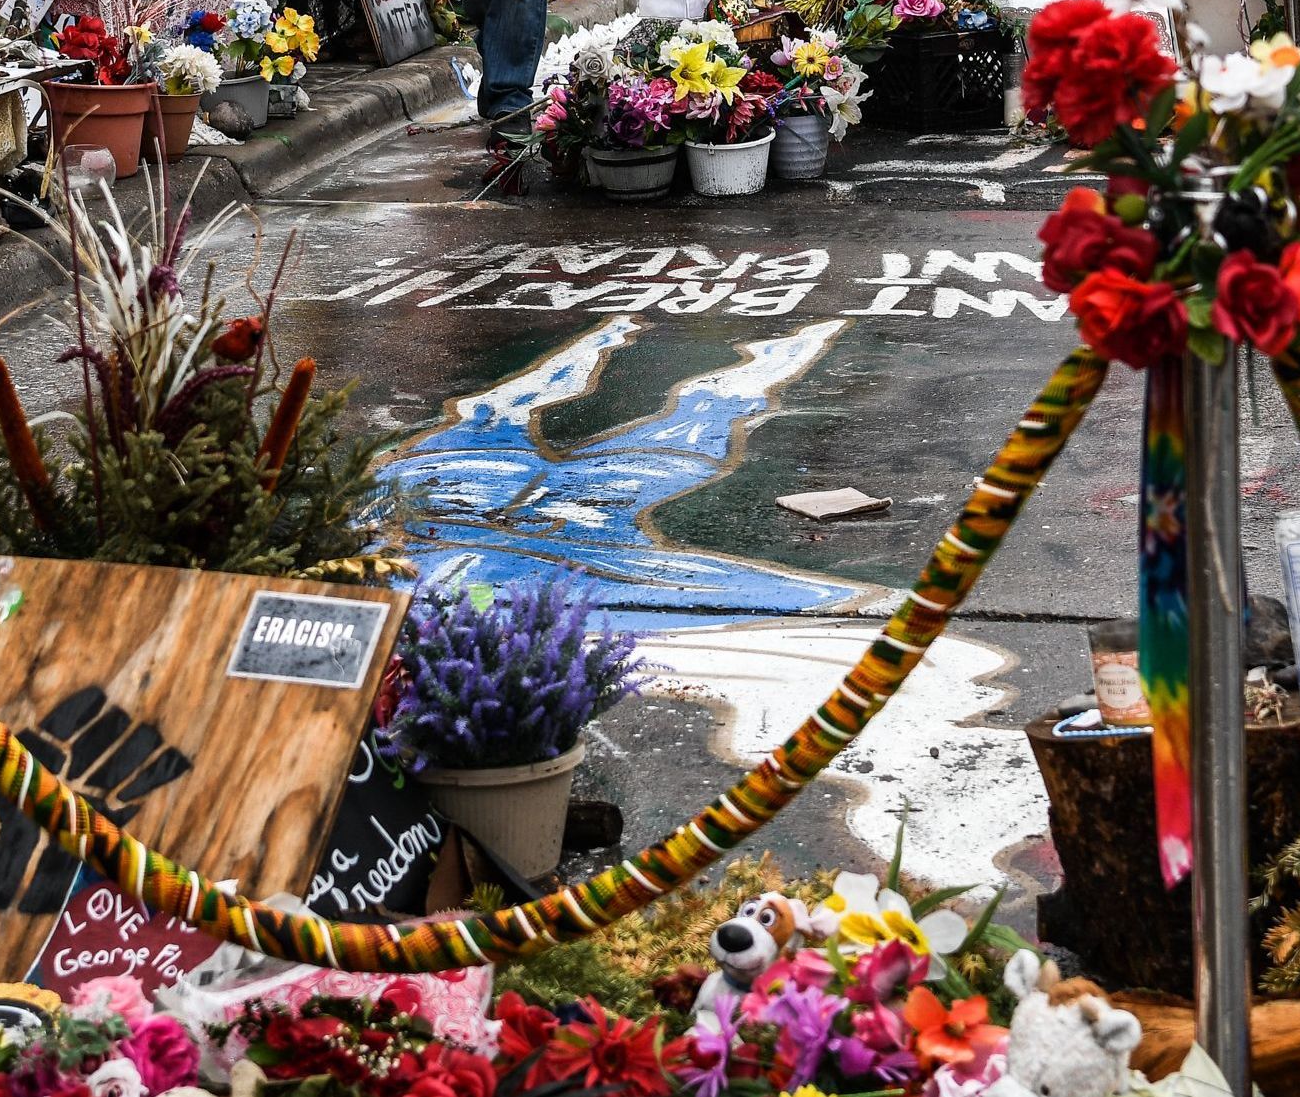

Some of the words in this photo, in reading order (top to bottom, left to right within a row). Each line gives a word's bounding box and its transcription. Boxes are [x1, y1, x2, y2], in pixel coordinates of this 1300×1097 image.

[841, 282, 1071, 322] ANT
[63, 887, 146, 943] LOVE
[53, 947, 151, 977] George
[151, 943, 186, 984] Flo
